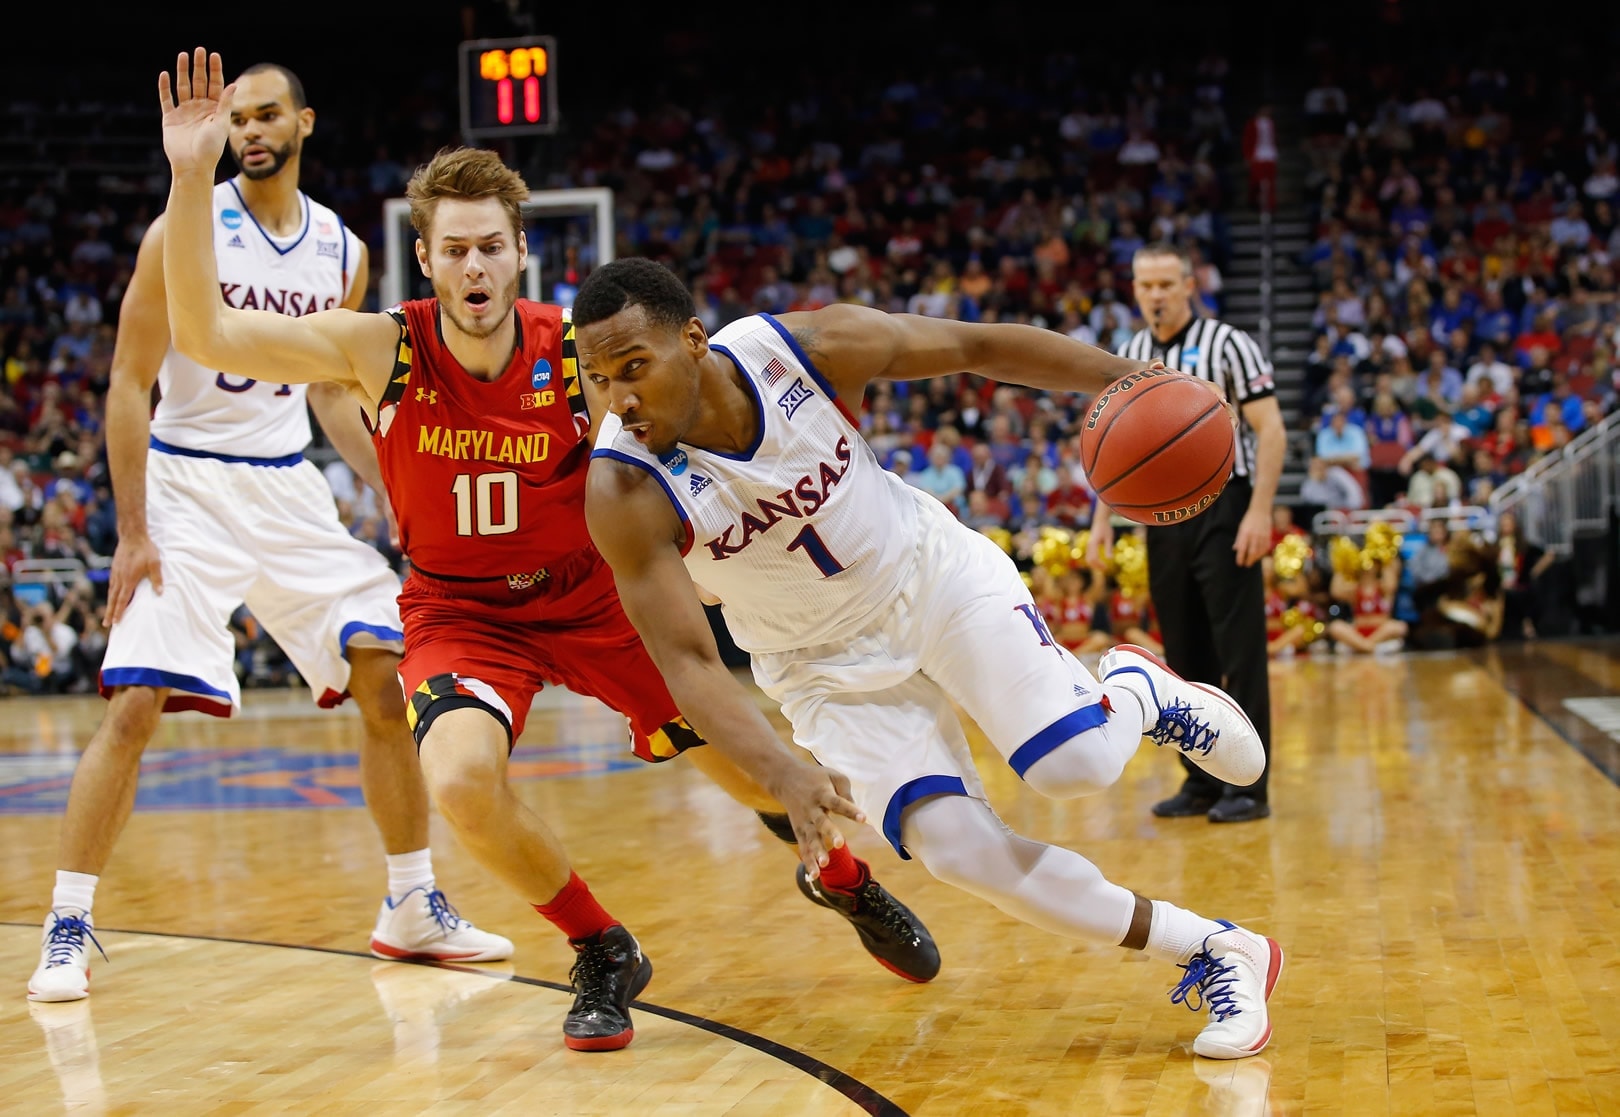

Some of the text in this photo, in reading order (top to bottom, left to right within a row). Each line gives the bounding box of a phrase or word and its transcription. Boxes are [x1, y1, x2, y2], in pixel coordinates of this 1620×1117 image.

[497, 77, 540, 124] 11
[417, 425, 550, 464] MARYLAND
[451, 471, 519, 536] 10
[692, 477, 713, 497] adidas
[704, 435, 852, 560] KANSAS
[786, 523, 857, 581] 1
